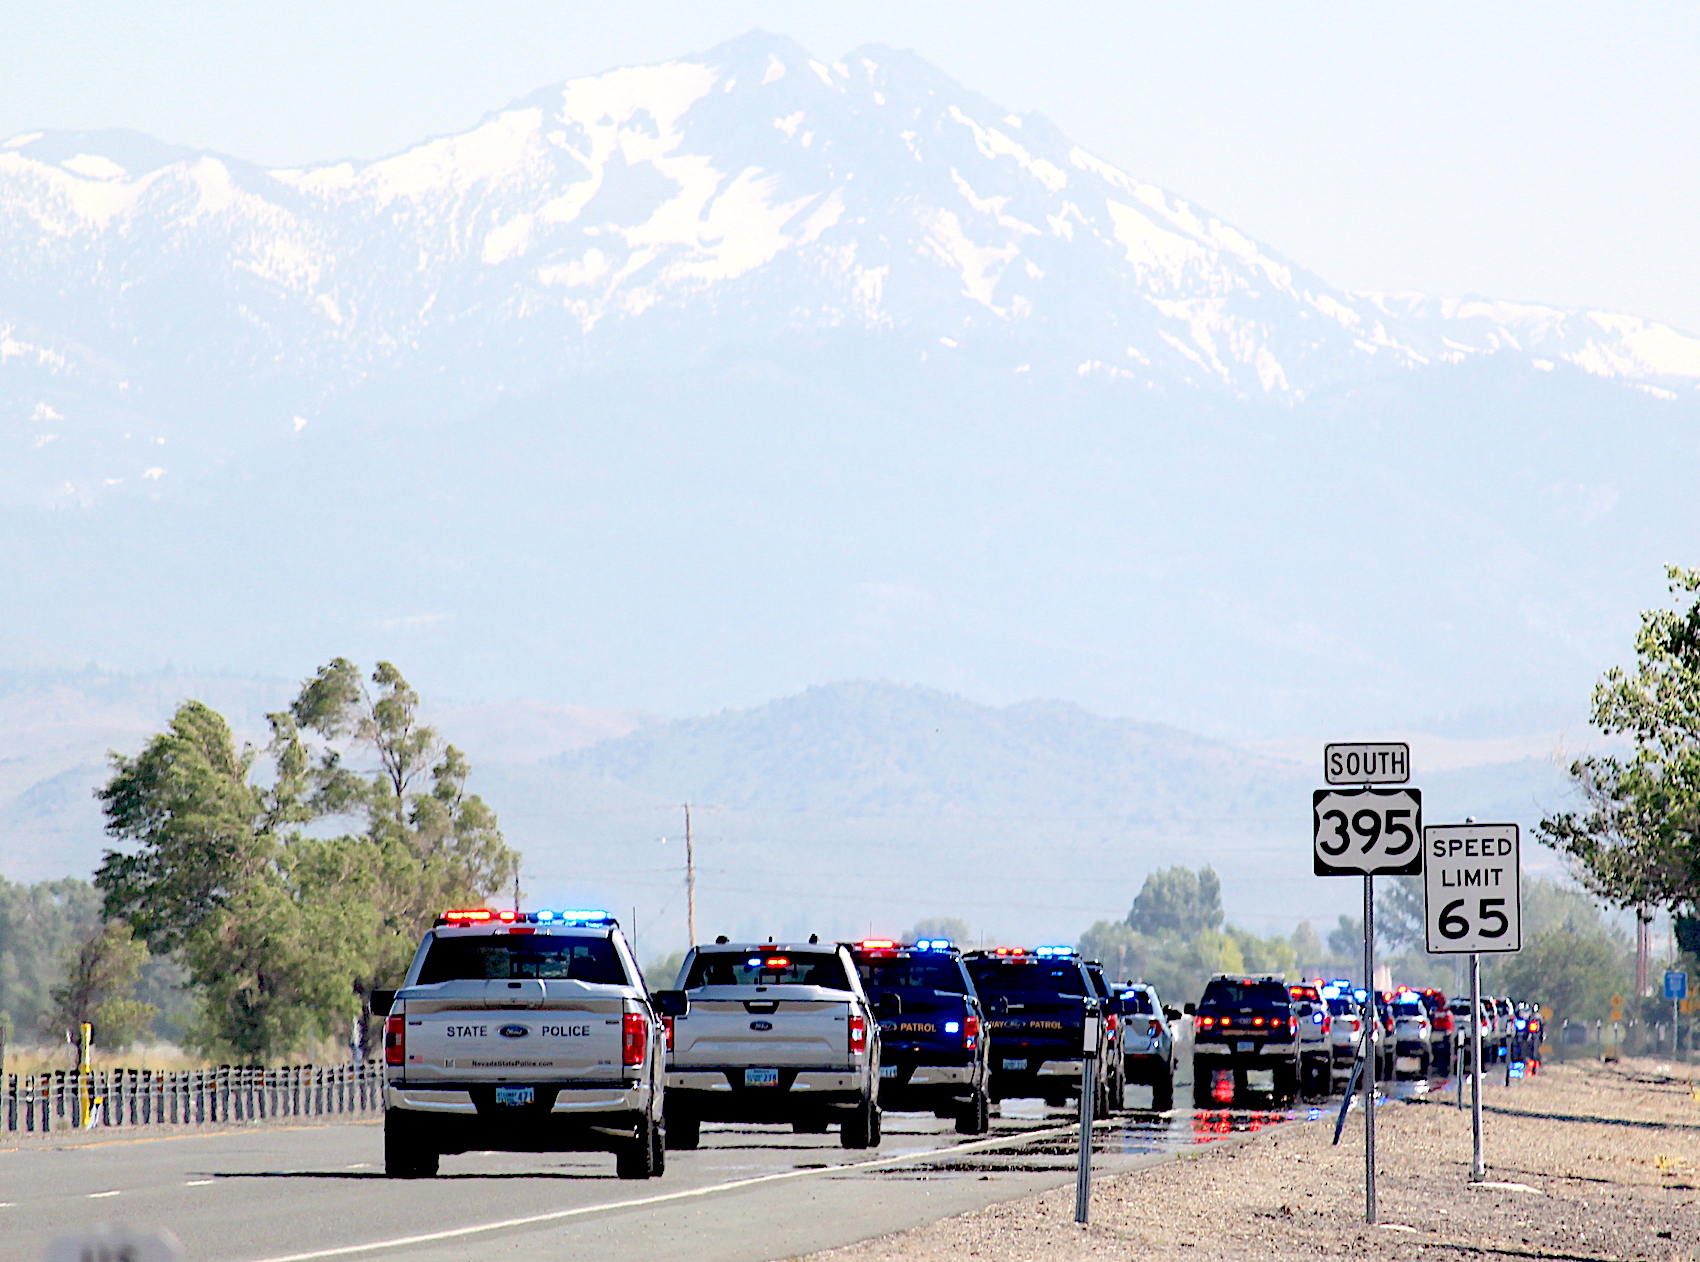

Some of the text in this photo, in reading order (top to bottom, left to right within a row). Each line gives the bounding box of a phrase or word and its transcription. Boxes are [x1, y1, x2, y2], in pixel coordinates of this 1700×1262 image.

[1331, 752, 1404, 775] SOUTH
[1320, 809, 1414, 855] 395
[1433, 838, 1512, 857] SPEED
[1442, 868, 1503, 886] LIMIT
[1438, 898, 1509, 939] 65
[447, 1025, 590, 1037] STATE POLICE
[900, 1022, 936, 1033] PATROL
[1029, 1020, 1063, 1030] PATROL
[472, 1059, 553, 1067] NevadaStatePolice.com
